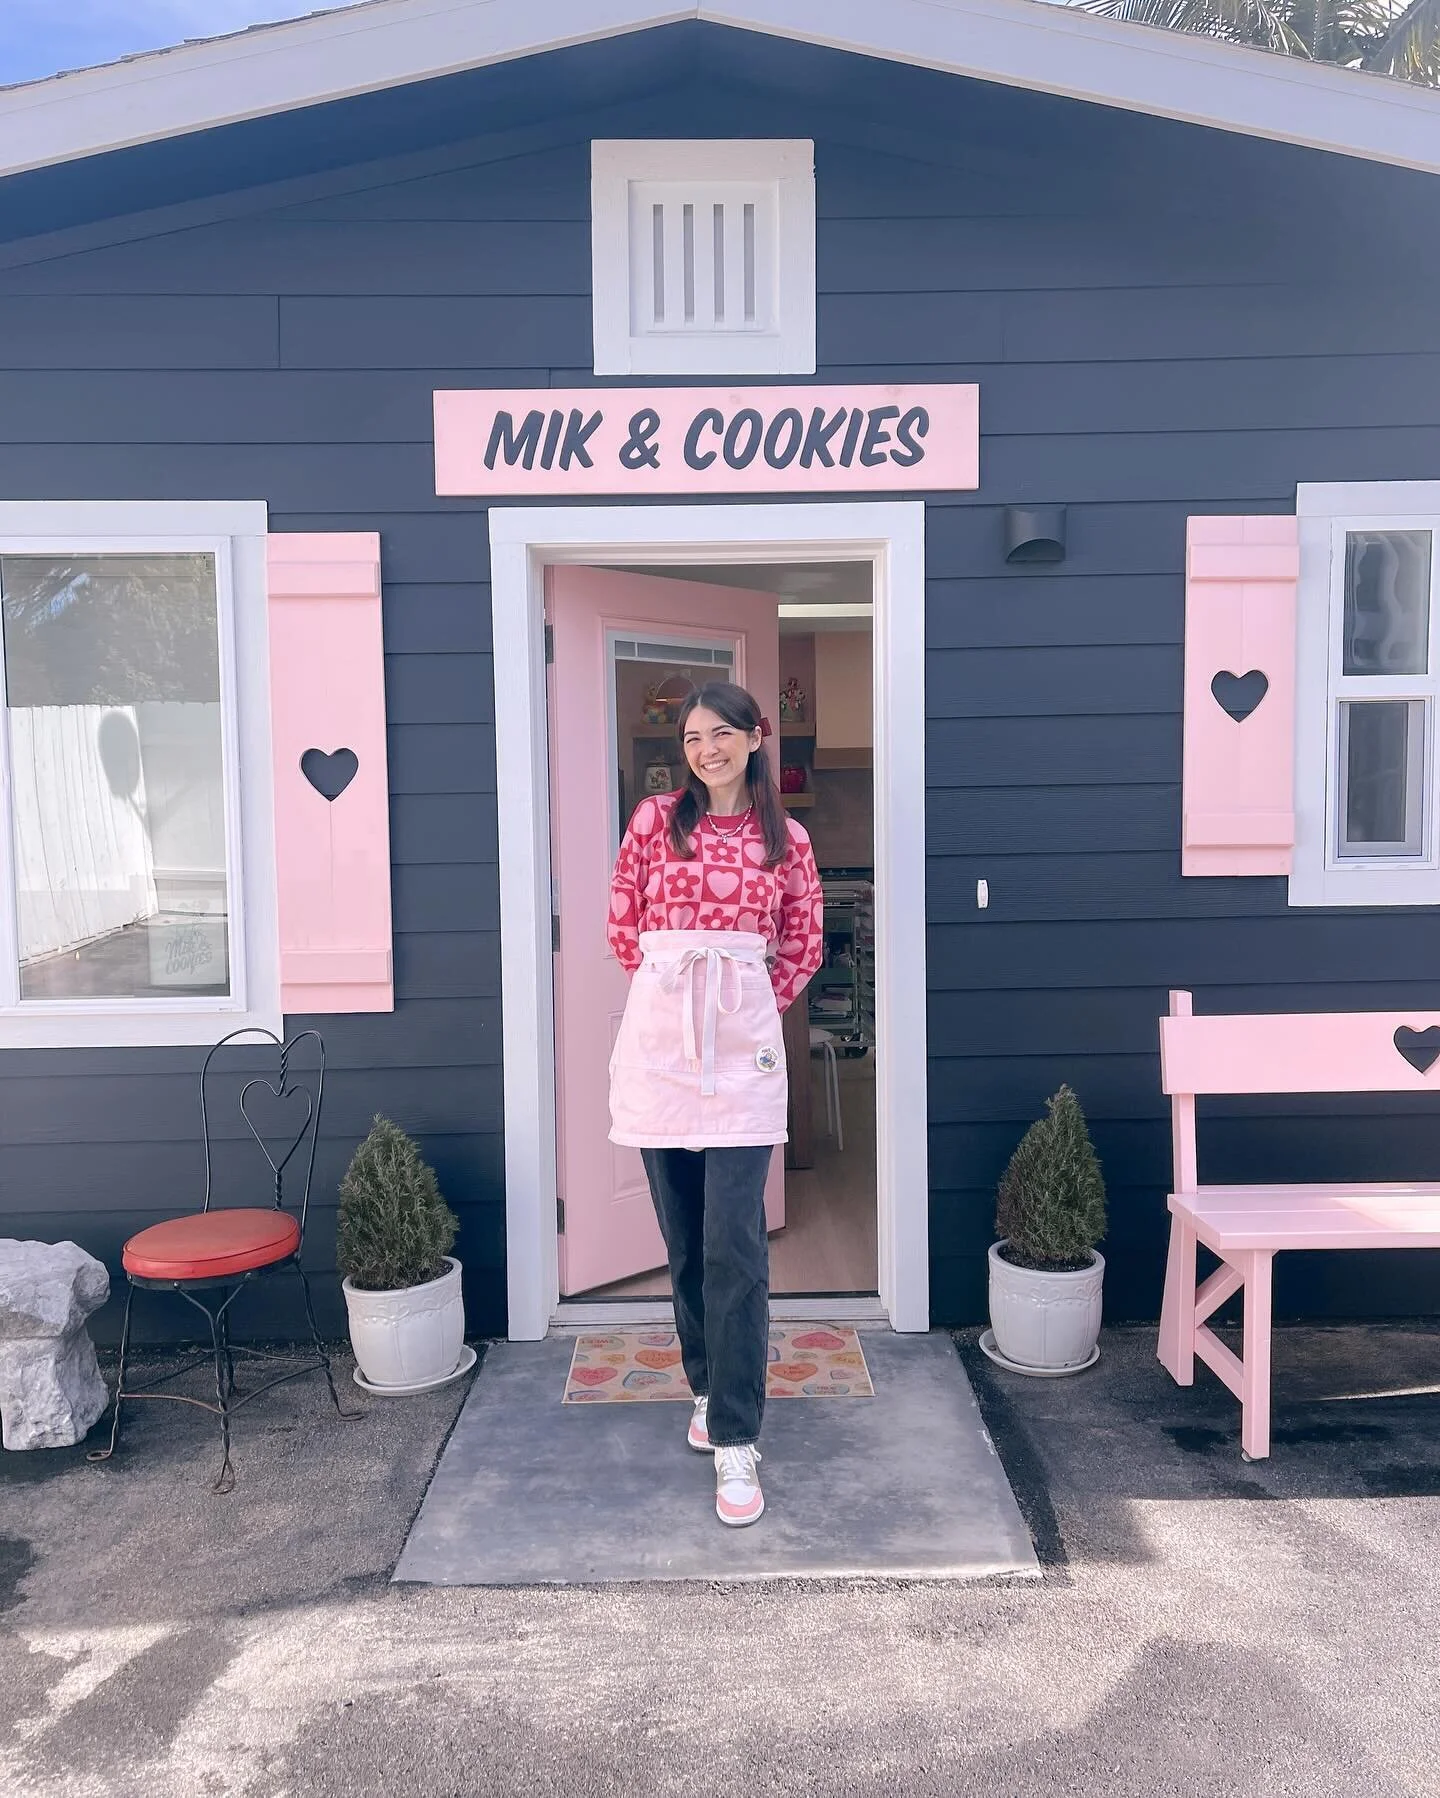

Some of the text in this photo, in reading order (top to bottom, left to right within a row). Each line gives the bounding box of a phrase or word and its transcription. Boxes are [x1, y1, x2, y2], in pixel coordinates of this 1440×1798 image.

[484, 406, 929, 471] MIK & COOKIES
